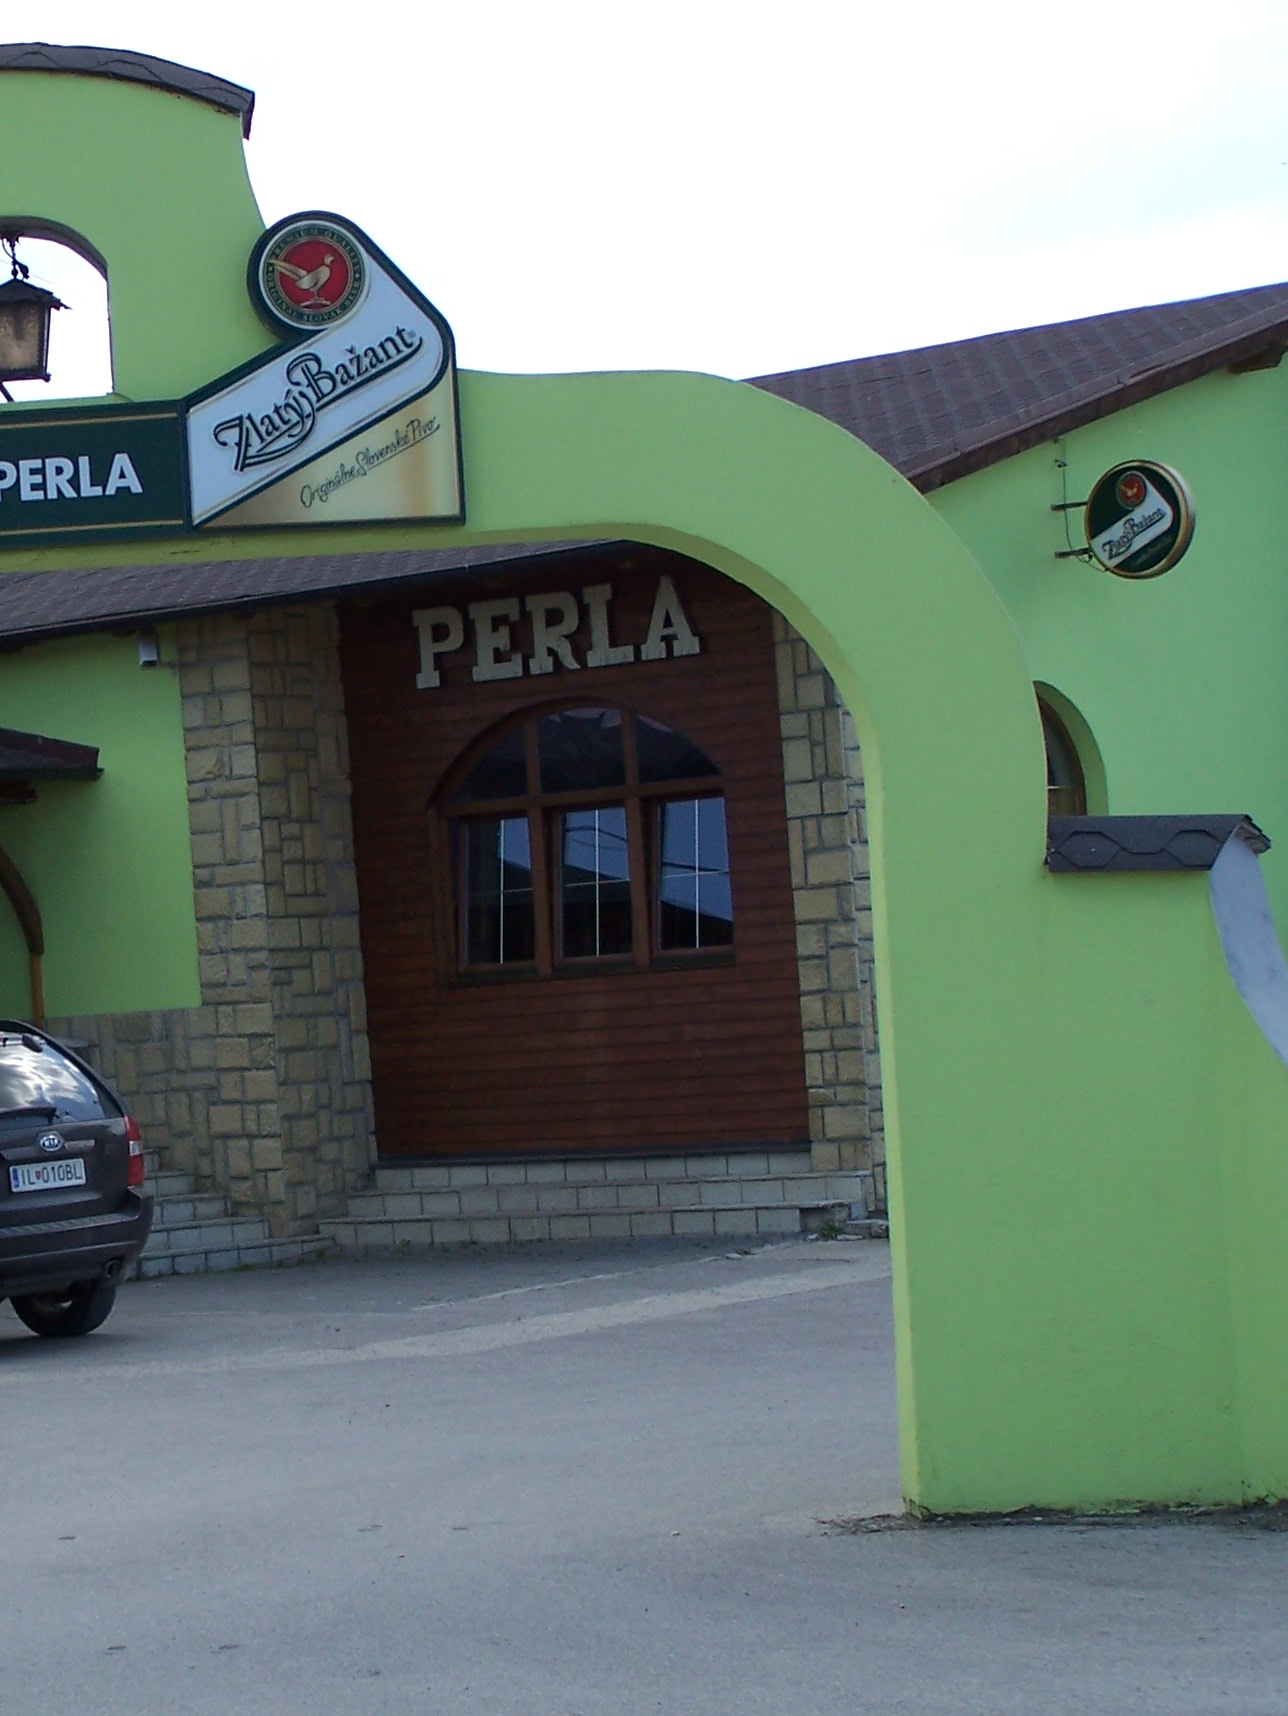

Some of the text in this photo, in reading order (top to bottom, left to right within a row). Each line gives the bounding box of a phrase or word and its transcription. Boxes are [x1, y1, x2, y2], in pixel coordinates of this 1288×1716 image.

[213, 326, 421, 472] Zlatý Bažant
[406, 416, 436, 441] Pivo
[413, 575, 700, 689] PERLA
